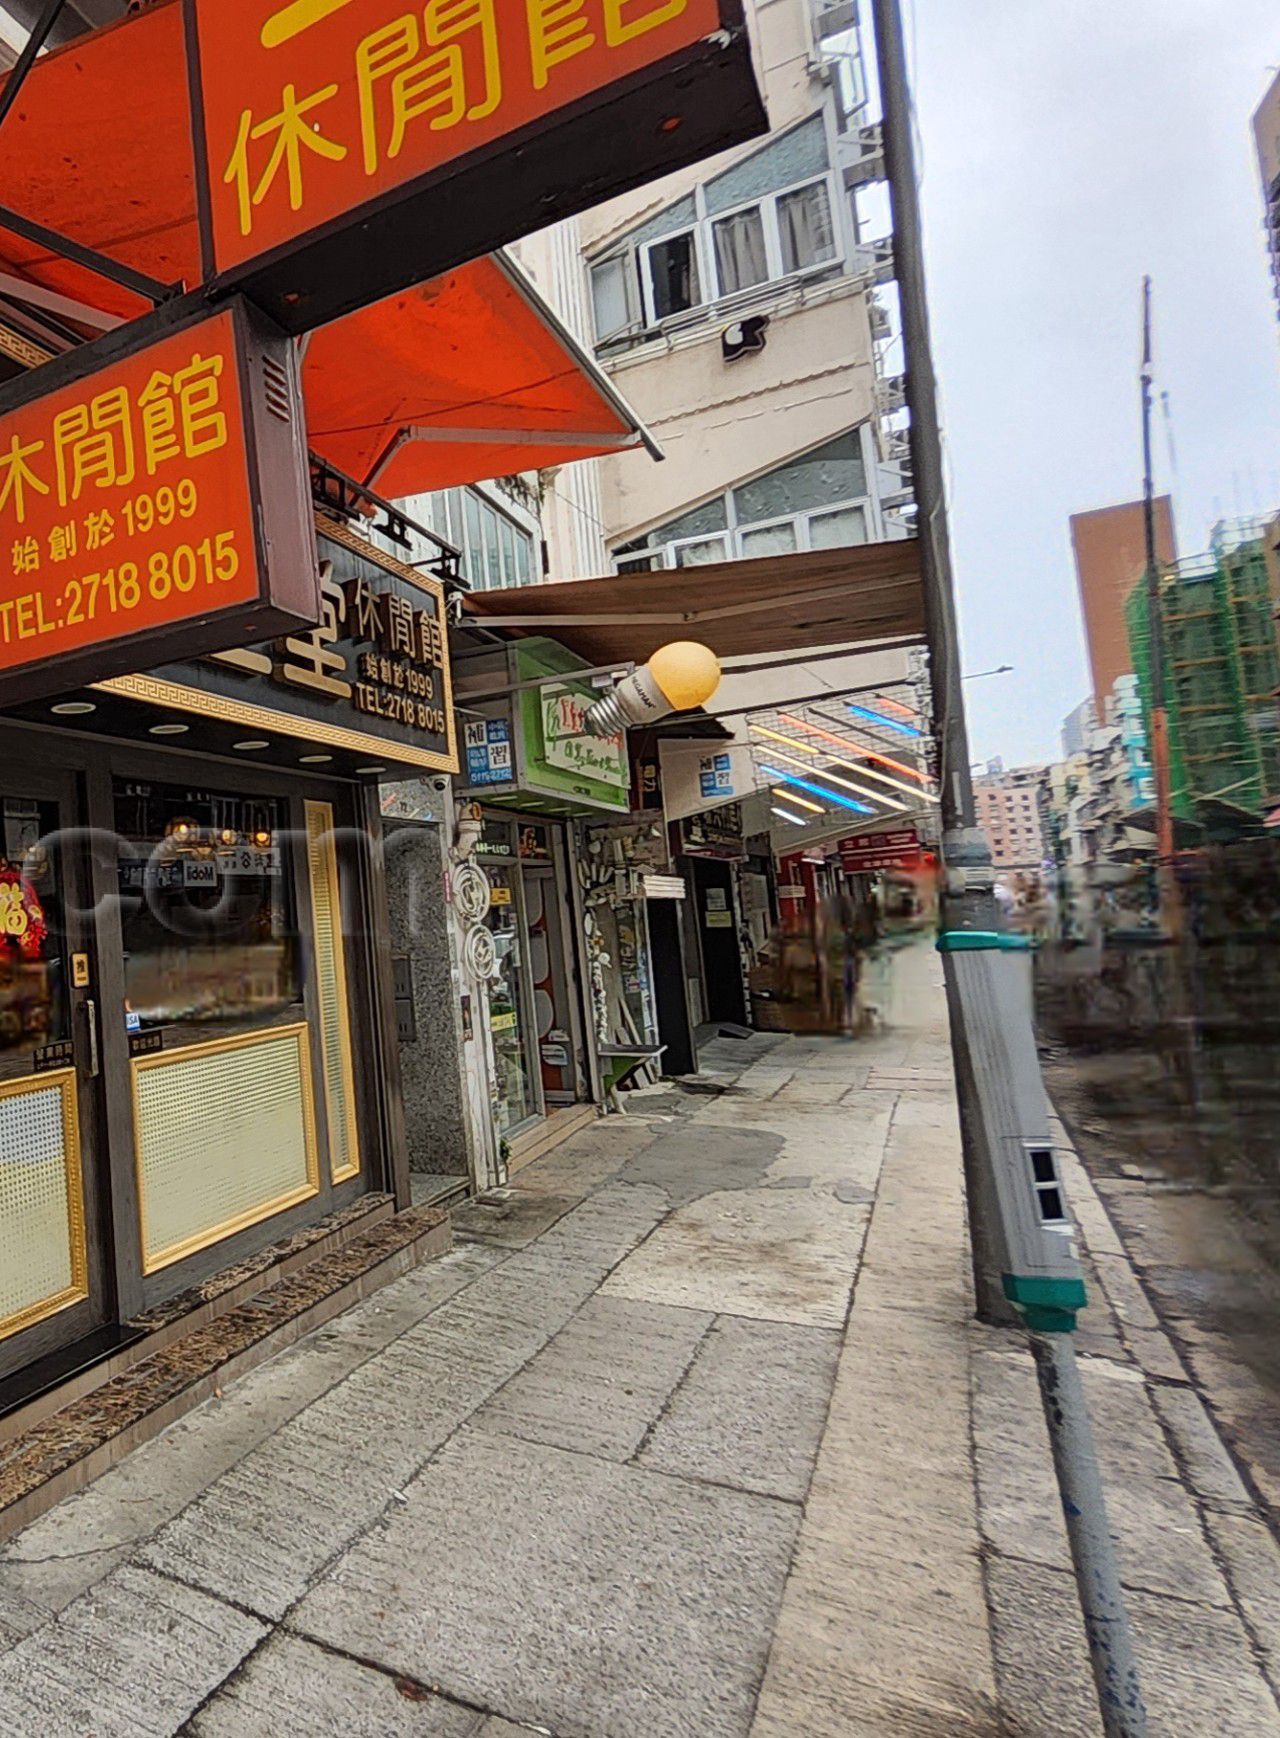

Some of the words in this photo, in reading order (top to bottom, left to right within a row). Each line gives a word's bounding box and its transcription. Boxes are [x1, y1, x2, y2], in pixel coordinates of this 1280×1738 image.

[10, 508, 116, 576] 始創於
[121, 478, 198, 537] 1999
[148, 530, 240, 600] 8015
[354, 577, 444, 670] 休閒館
[355, 681, 415, 726] TEL:2718
[417, 705, 446, 735] 8015
[406, 668, 433, 700] 1999
